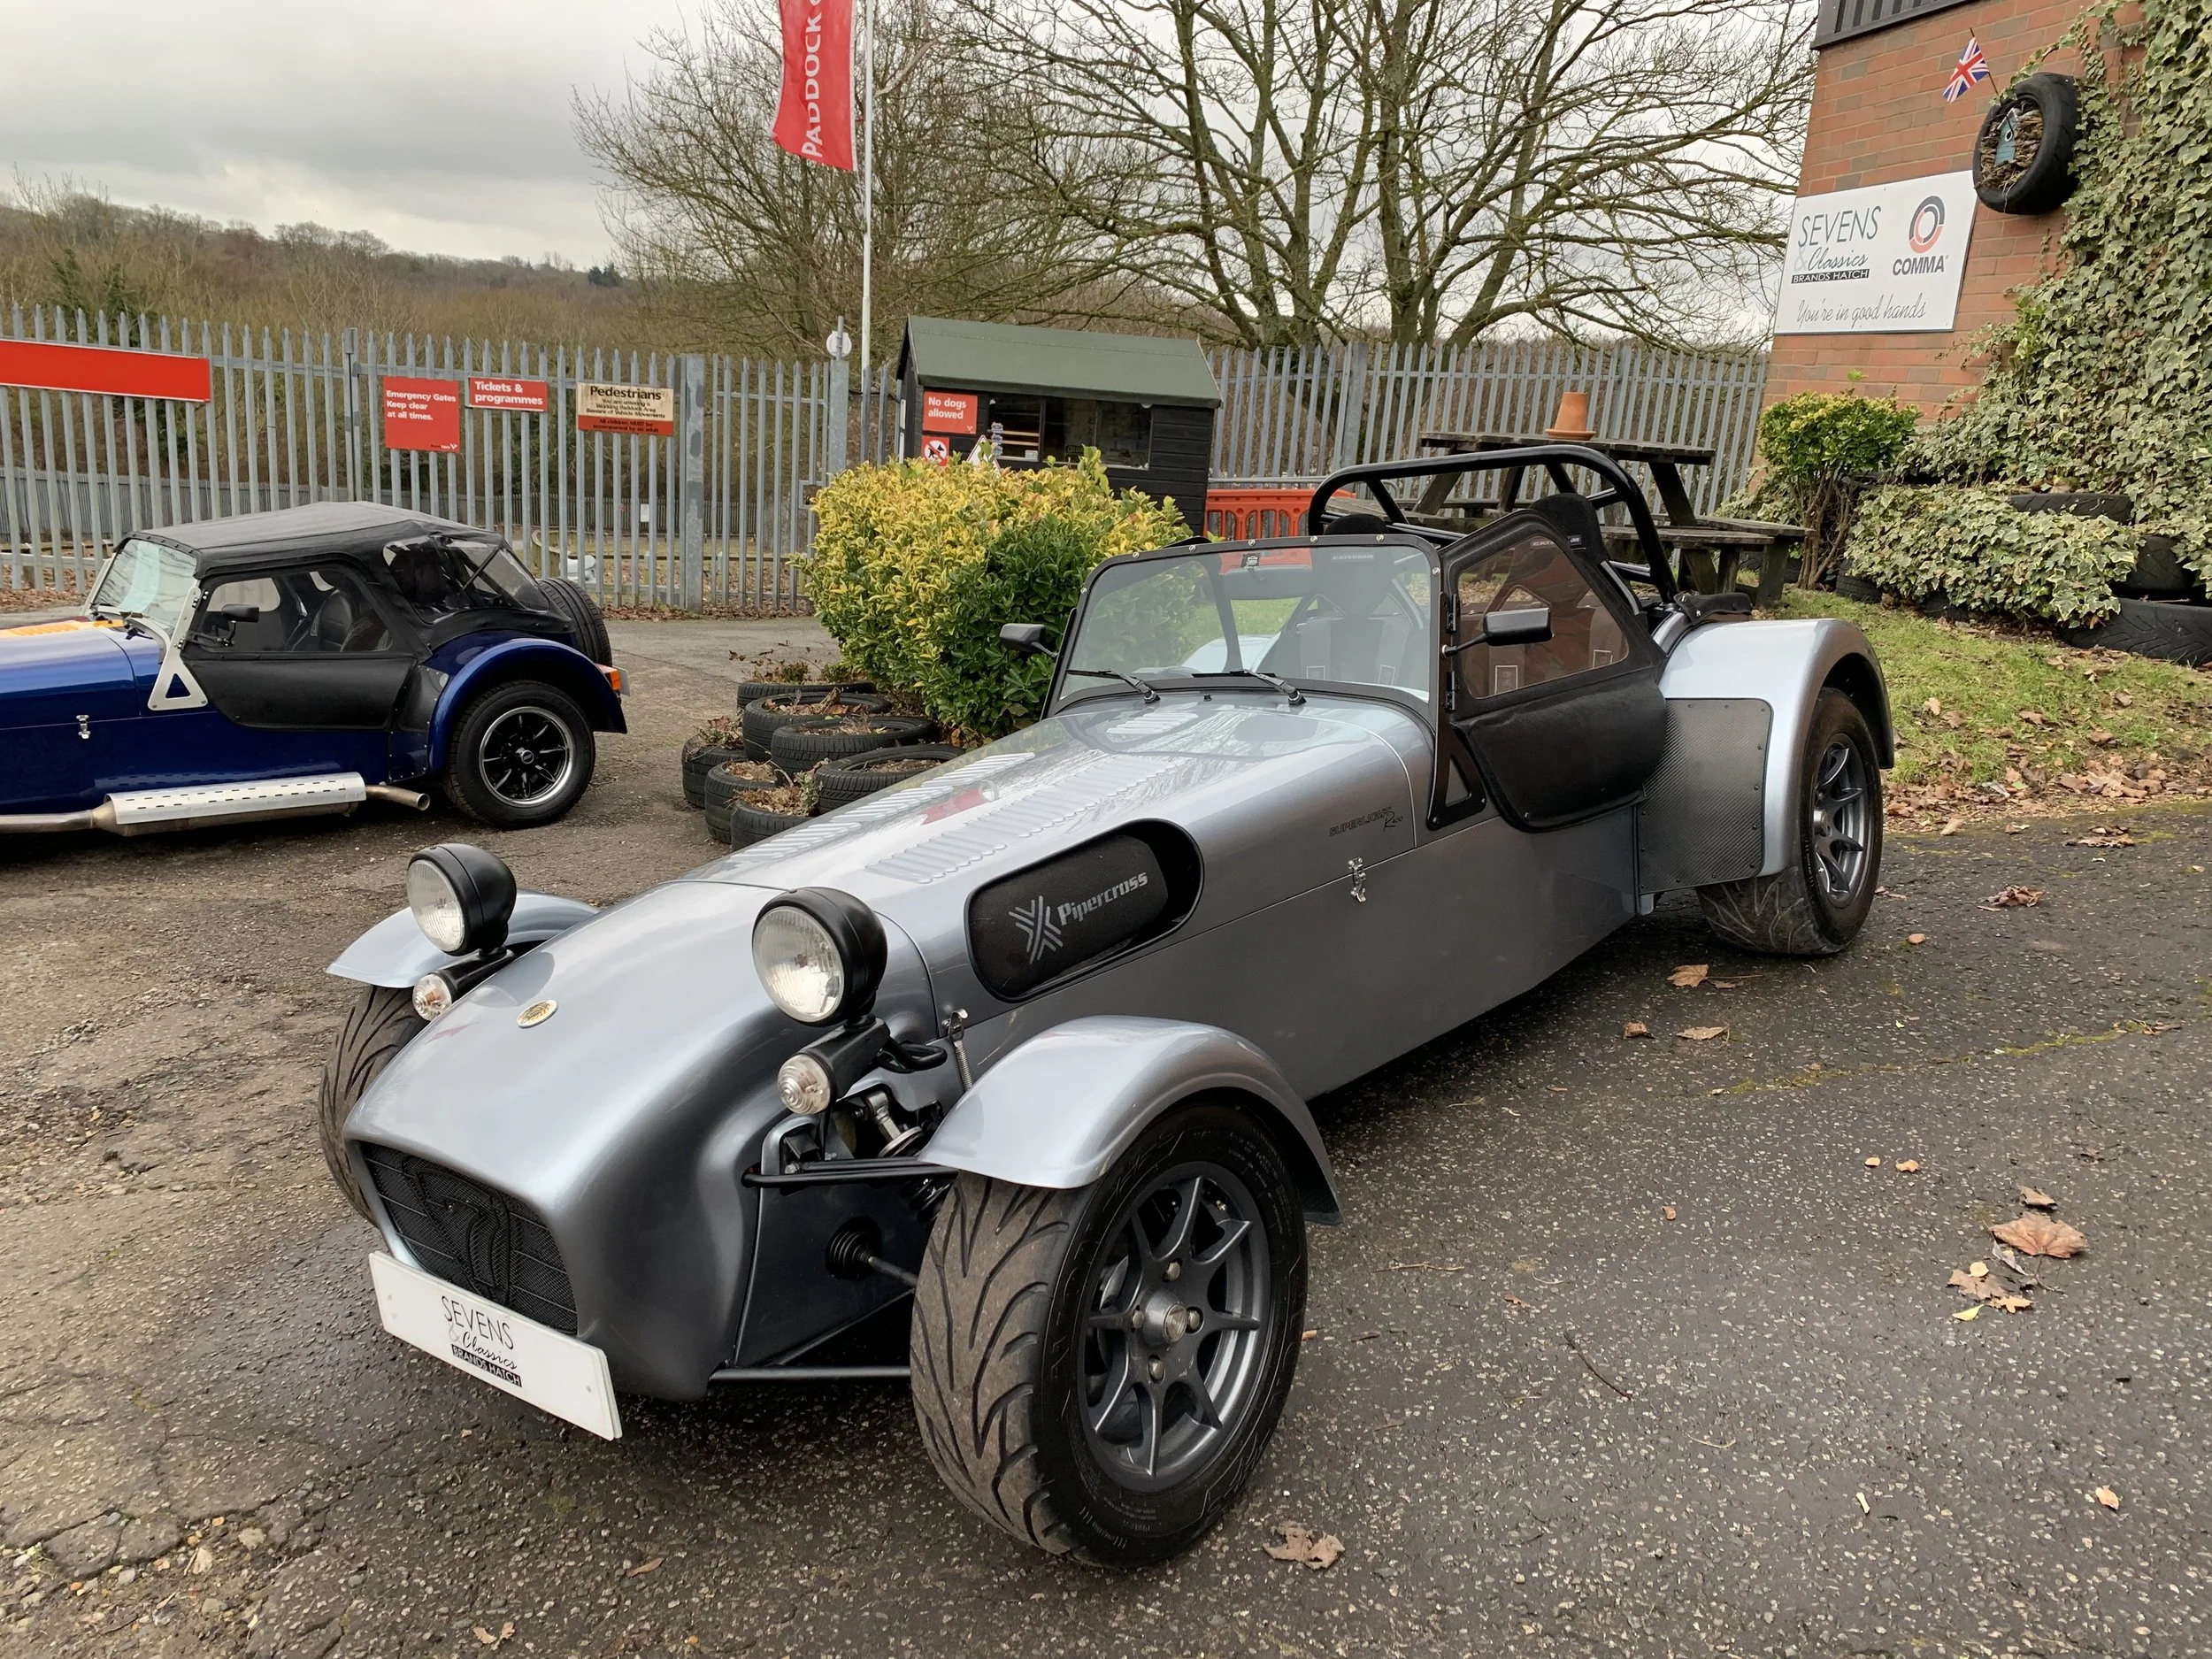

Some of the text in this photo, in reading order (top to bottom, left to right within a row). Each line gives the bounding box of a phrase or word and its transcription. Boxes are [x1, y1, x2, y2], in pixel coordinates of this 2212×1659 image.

[801, 12, 822, 157] PADDOCK
[1798, 205, 1881, 247] SEVENS
[1808, 247, 1868, 272] Classics
[1793, 269, 1869, 283] BRANDS HATCH
[1796, 293, 1927, 329] You're in good hands
[474, 380, 524, 394] Tickets &
[590, 386, 662, 400] Pedestrians
[387, 390, 457, 403] Emergency Gates
[475, 394, 543, 405] programmes
[928, 397, 967, 410] No dogs
[387, 401, 406, 410] Keep
[409, 412, 433, 421] times.
[928, 408, 964, 419] allowed
[1057, 872, 1148, 926] Pipercross
[442, 1295, 514, 1350] SEVENS
[462, 1332, 518, 1370] Classics
[452, 1347, 522, 1386] BRANDS HATCH
